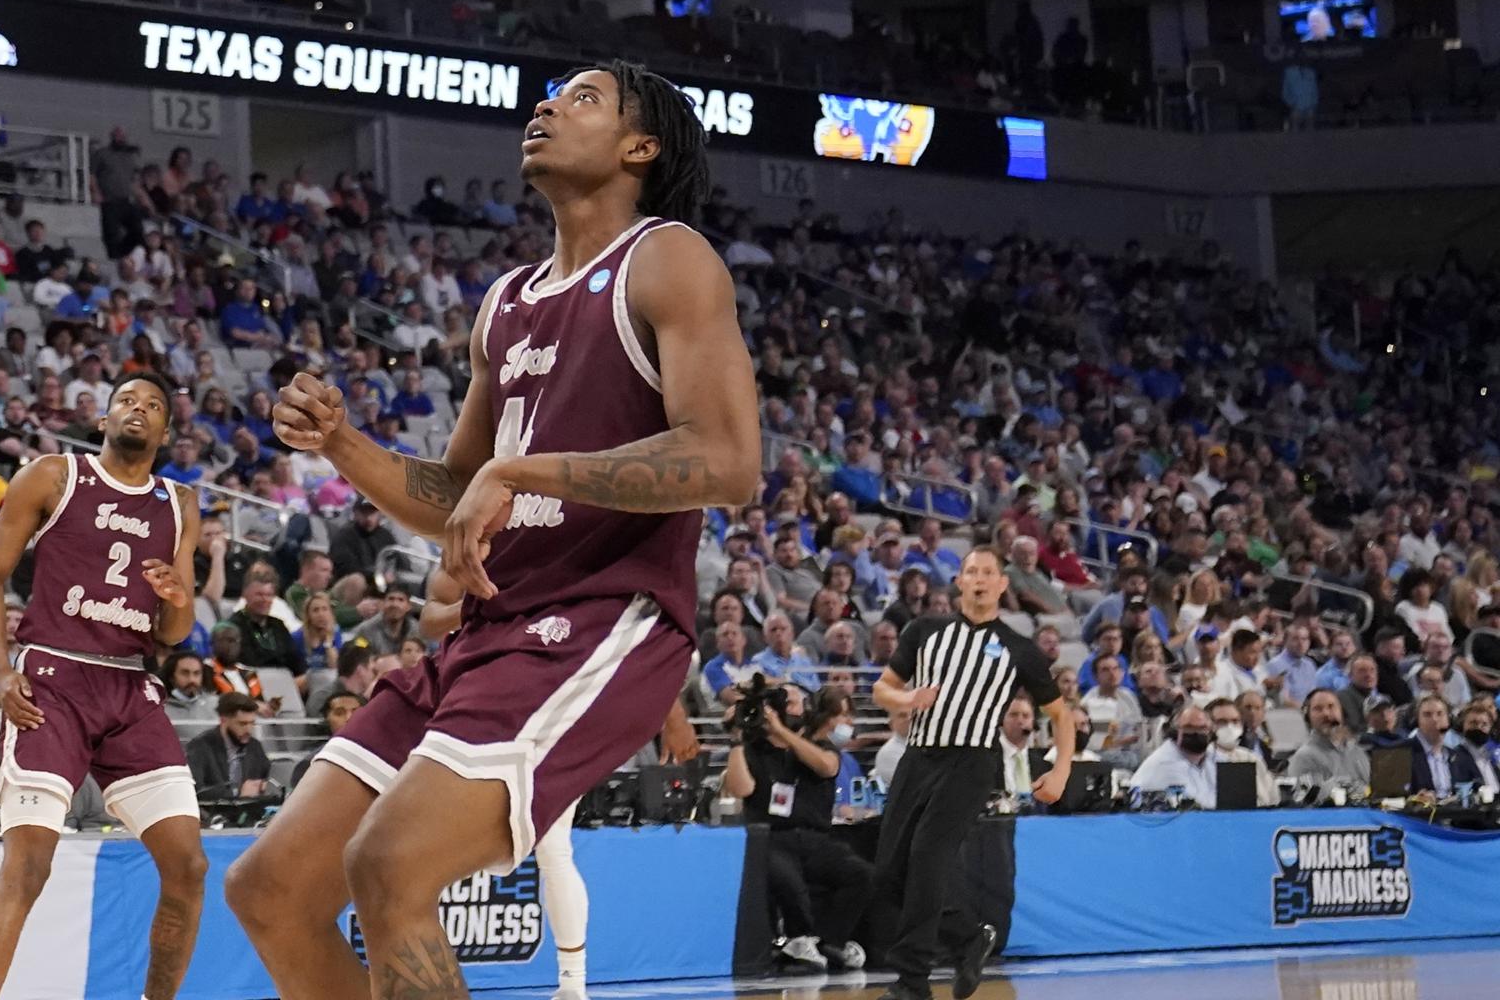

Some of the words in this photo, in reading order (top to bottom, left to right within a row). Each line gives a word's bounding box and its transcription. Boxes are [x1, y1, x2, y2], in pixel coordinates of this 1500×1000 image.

[140, 22, 283, 82] TEXAS
[294, 41, 519, 110] SOUTHERN
[162, 97, 212, 130] 125
[95, 503, 150, 538] Texas
[105, 541, 132, 588] 2
[62, 585, 152, 632] Southern
[1299, 834, 1369, 870] MARCH
[1312, 868, 1408, 906] MADNESS
